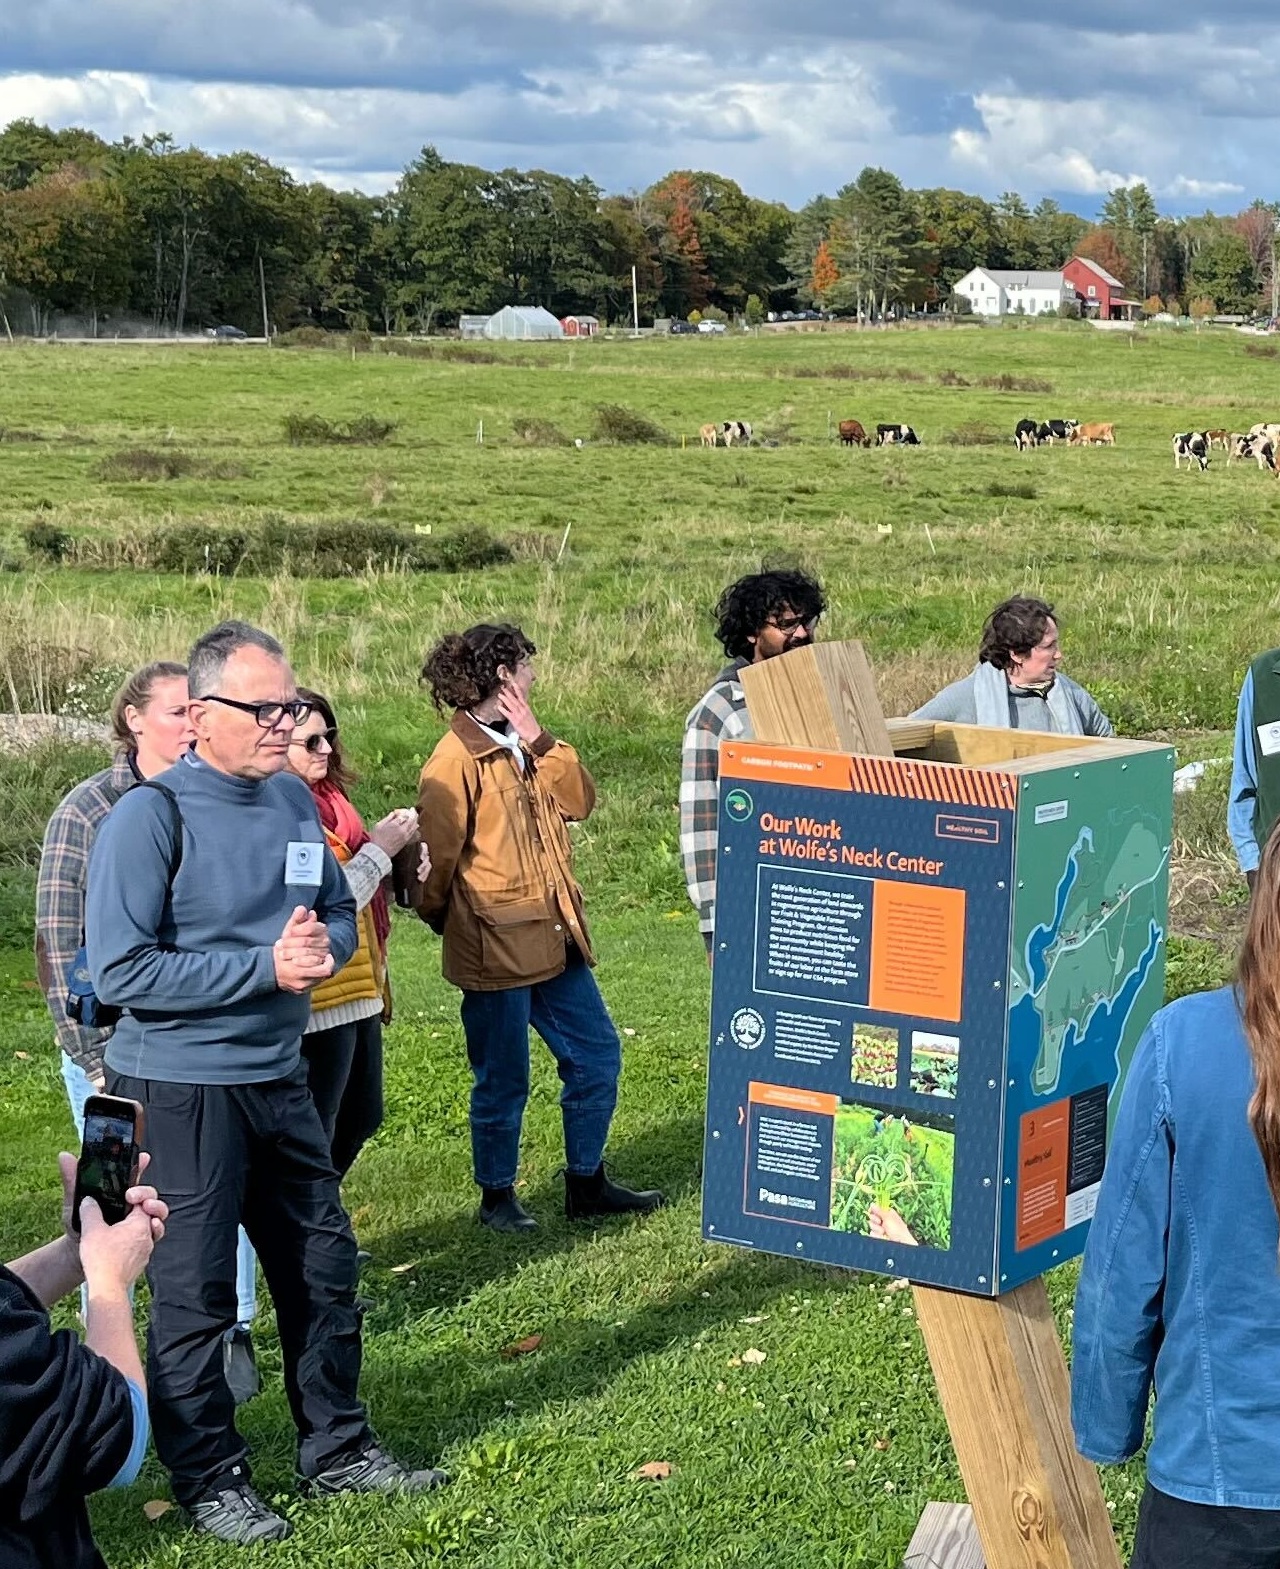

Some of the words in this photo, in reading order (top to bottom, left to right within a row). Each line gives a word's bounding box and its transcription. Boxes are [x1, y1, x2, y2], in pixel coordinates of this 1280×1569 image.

[760, 813, 792, 834] Our
[794, 817, 841, 840] Work
[759, 838, 776, 854] at
[779, 838, 838, 863] Wolfe's
[842, 846, 883, 869] Neck
[887, 852, 944, 875] Center
[1029, 1121, 1035, 1137] 3
[759, 1188, 787, 1205] Pasa
